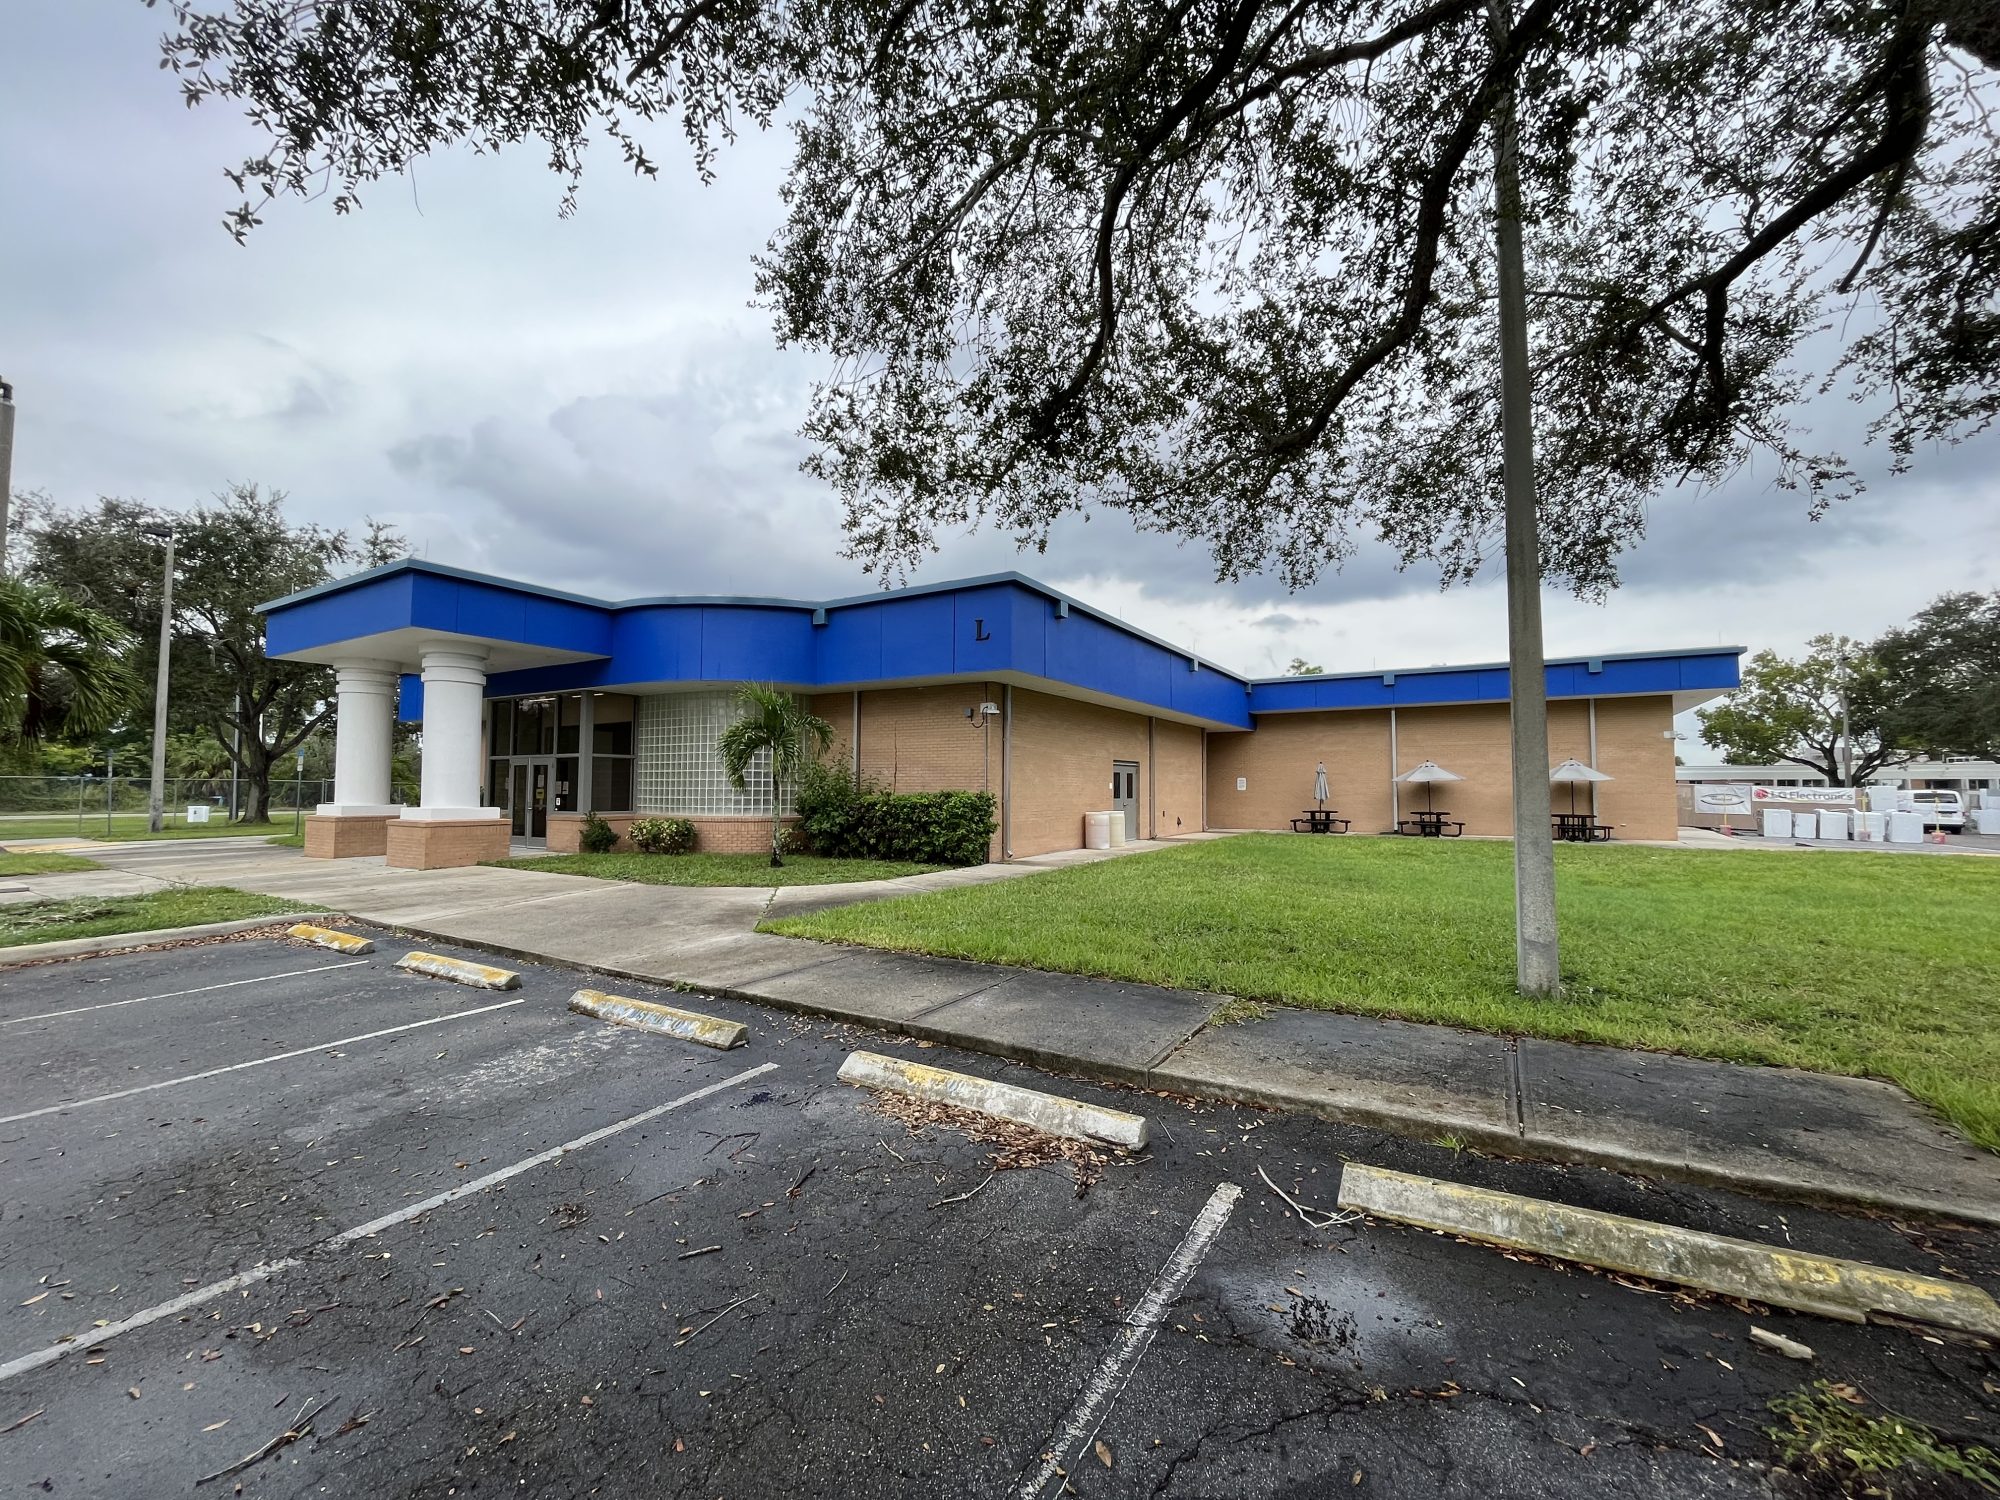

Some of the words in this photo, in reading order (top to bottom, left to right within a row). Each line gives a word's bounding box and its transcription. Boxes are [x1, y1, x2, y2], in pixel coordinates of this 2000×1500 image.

[975, 619, 991, 641] L
[1770, 790, 1787, 800] LG
[1789, 791, 1854, 802] Electronics
